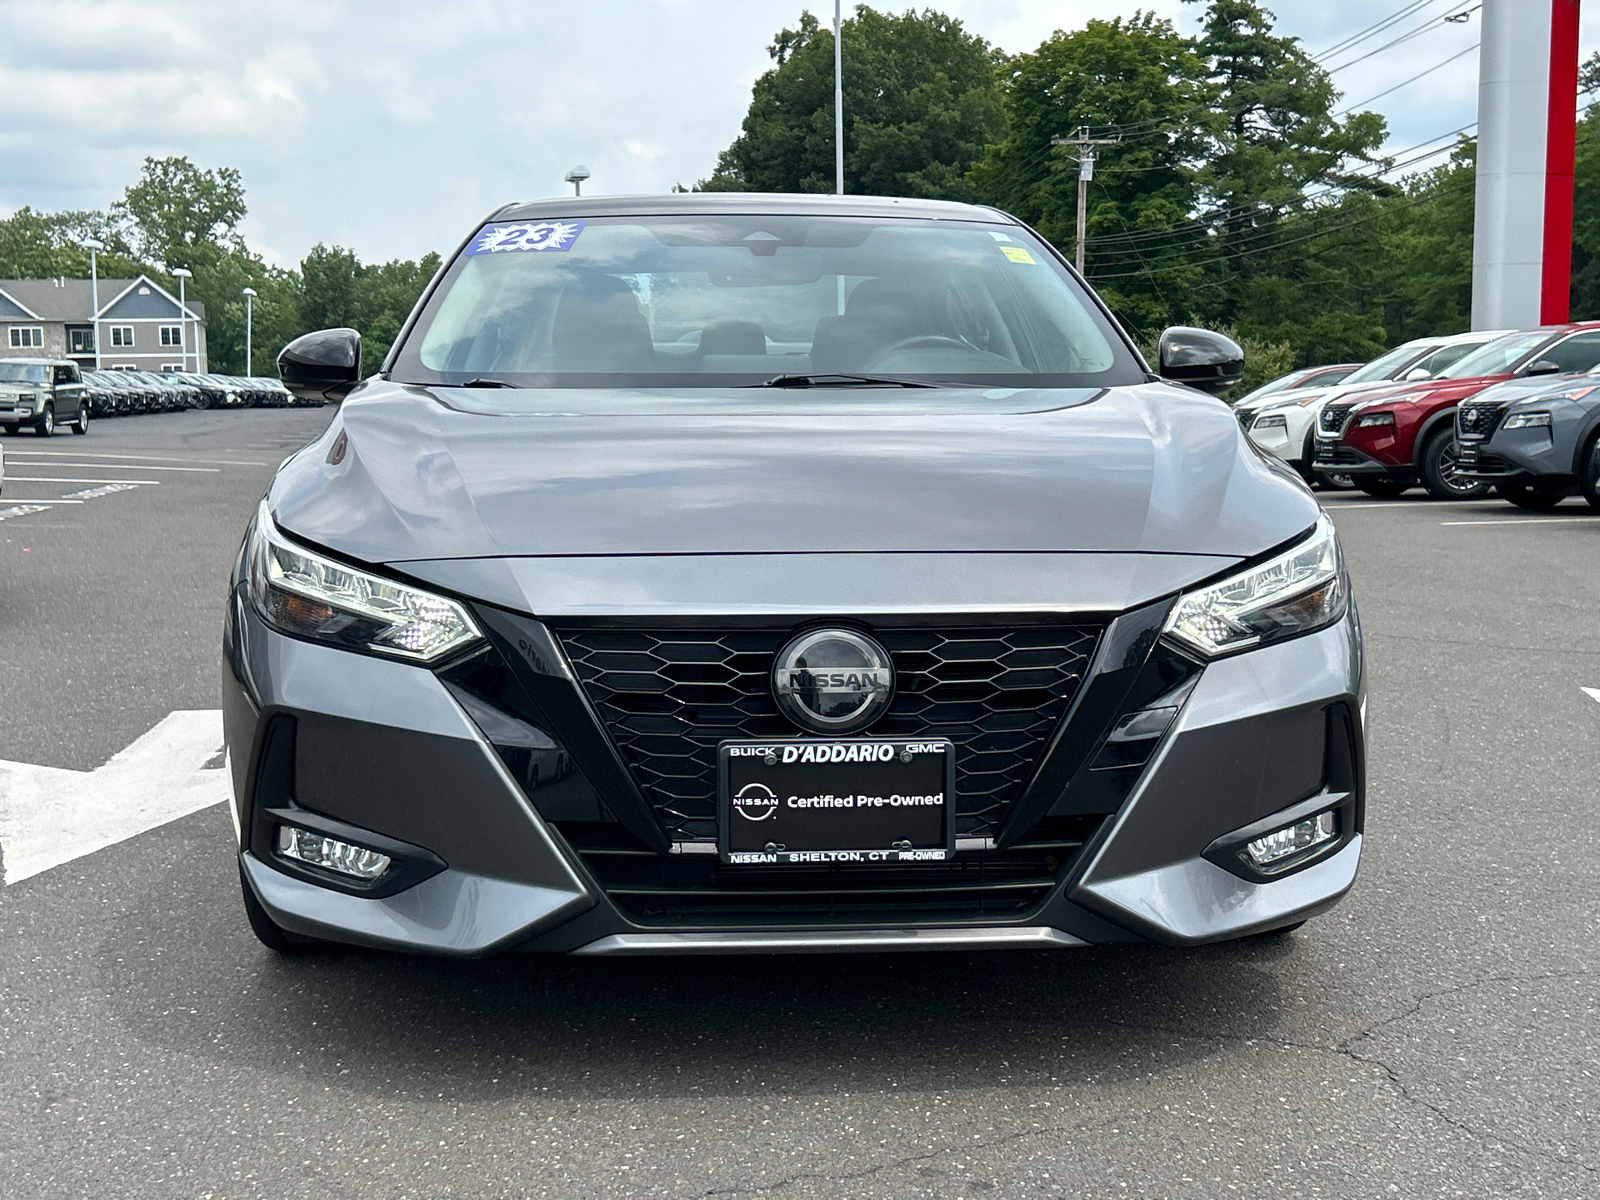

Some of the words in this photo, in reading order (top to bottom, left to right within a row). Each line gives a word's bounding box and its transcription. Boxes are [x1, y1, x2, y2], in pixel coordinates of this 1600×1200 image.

[496, 228, 554, 246] 23
[789, 673, 878, 688] NISSAN
[730, 747, 776, 756] BUICK
[782, 744, 894, 763] D'ADDARIO
[905, 743, 945, 753] GMC
[733, 798, 779, 806] NISSAN
[787, 795, 853, 808] Certified
[857, 793, 944, 807] Pre-Owned
[730, 853, 777, 863] NISSAN
[789, 851, 865, 862] SHELTON,
[868, 851, 889, 861] CT
[898, 851, 946, 861] PRE-OWNED
